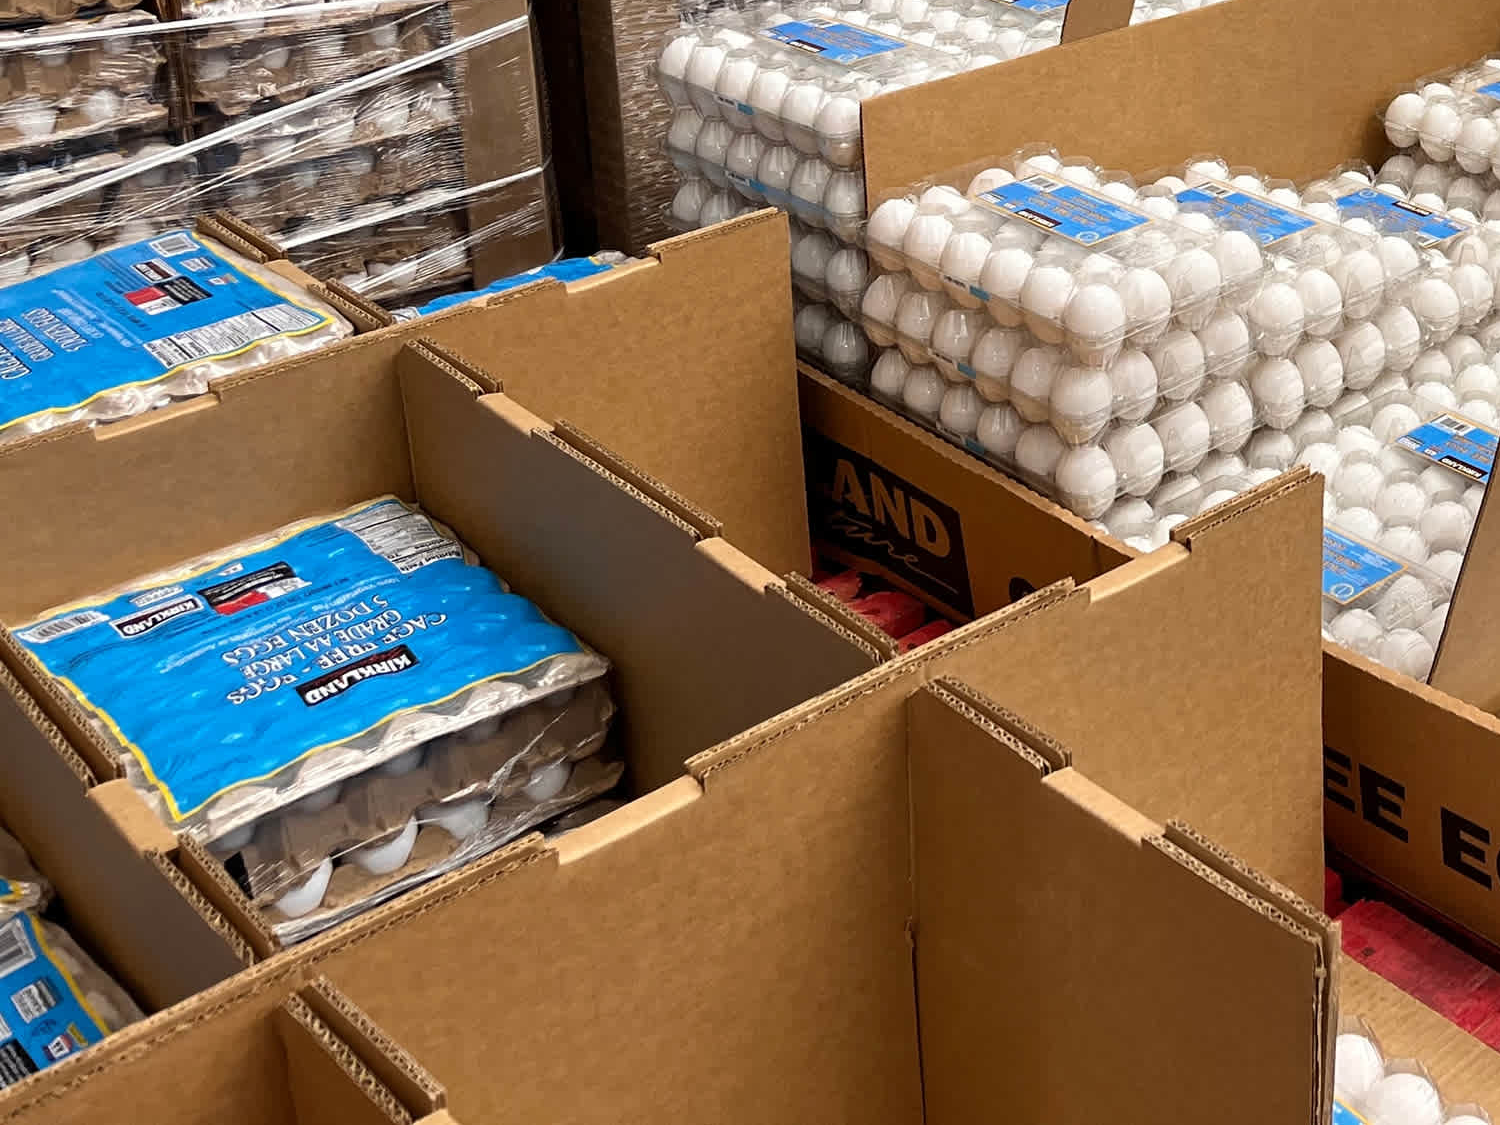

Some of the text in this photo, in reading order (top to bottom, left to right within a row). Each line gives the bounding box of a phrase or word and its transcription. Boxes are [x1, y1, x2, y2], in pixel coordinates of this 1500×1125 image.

[125, 599, 196, 636] KIRKLAND
[222, 594, 389, 667] 5 DOZEN EGGS
[239, 609, 402, 677] GRADE AA LARGE
[304, 653, 413, 705] KIRKLAND
[1324, 753, 1409, 843] EE
